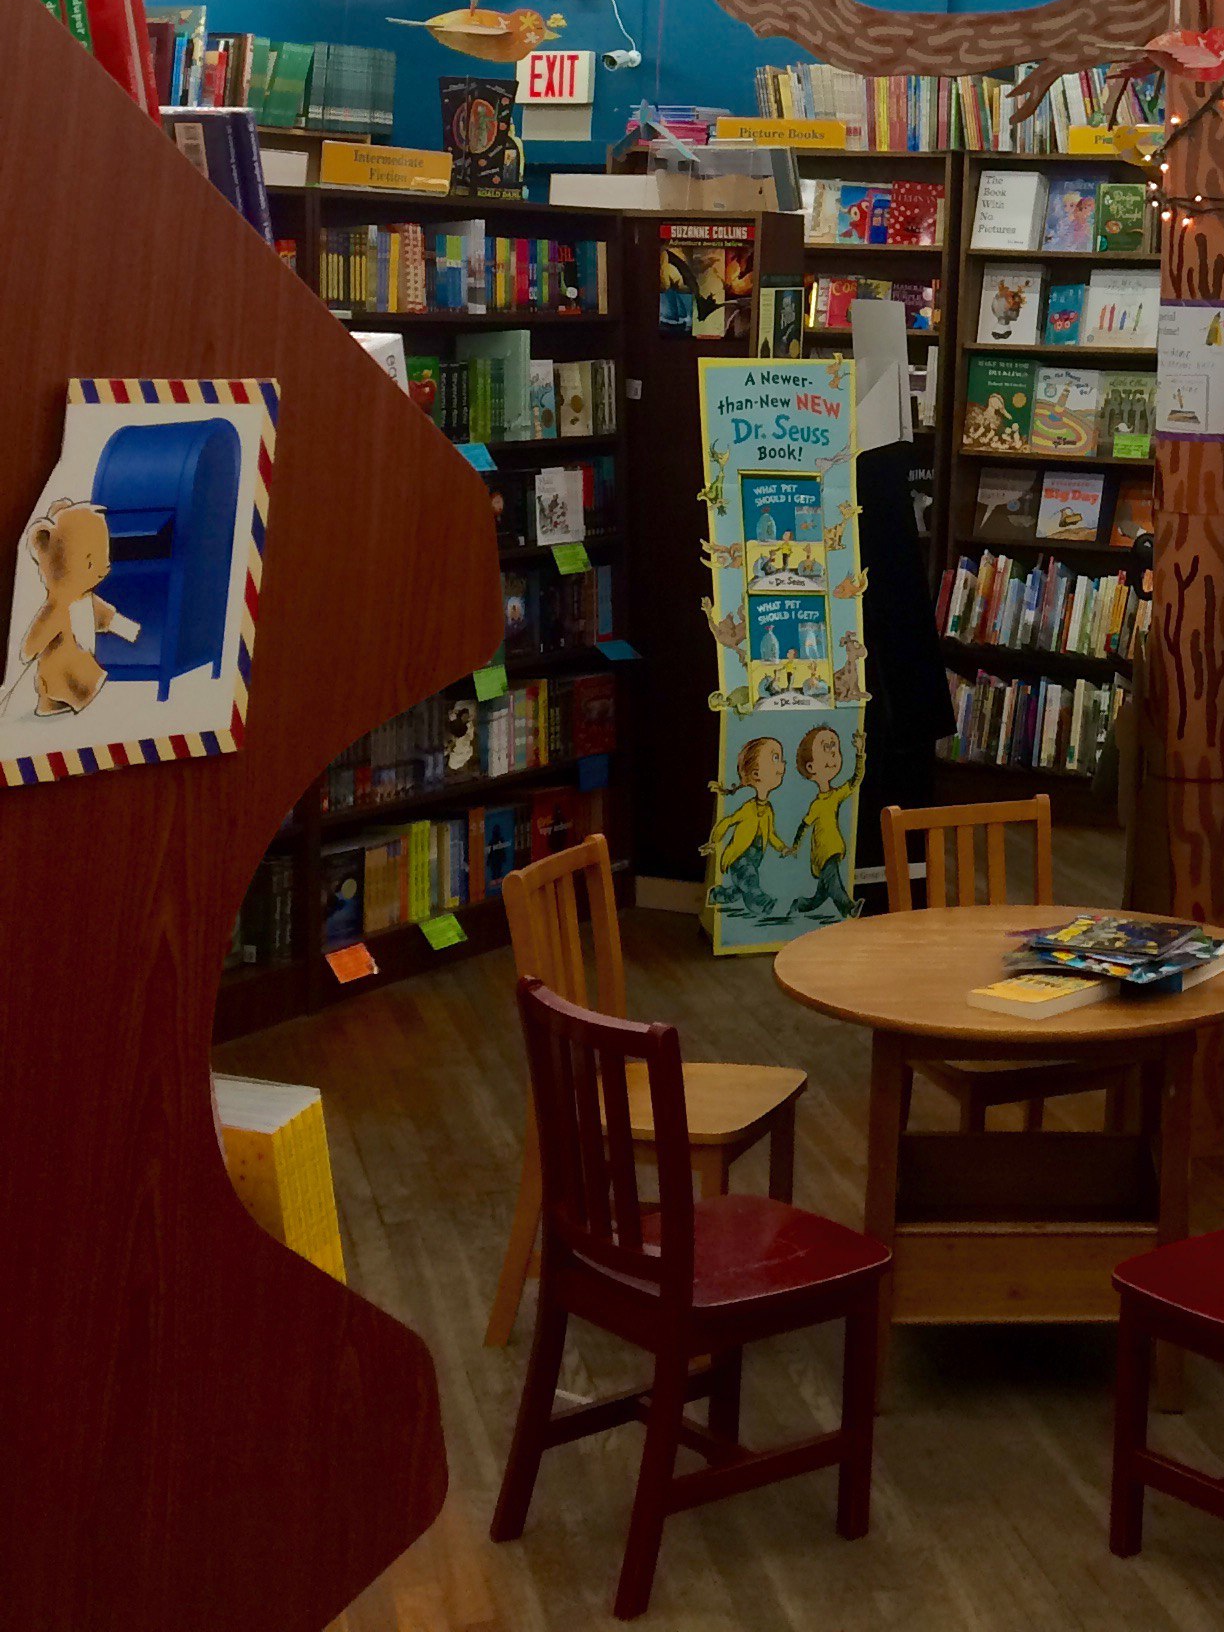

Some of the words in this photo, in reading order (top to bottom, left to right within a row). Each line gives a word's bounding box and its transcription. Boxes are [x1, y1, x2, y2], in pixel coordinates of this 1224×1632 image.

[529, 54, 579, 98] EXIT
[739, 127, 785, 140] Picture
[788, 128, 825, 140] Books
[353, 149, 425, 168] Intermediate
[368, 168, 408, 183] Fiction
[985, 175, 1004, 185] The
[983, 188, 1007, 198] Book
[981, 200, 1005, 210] With
[979, 212, 994, 222] No
[670, 225, 710, 238] SUZANNE
[712, 226, 748, 239] COLLINS
[977, 224, 1017, 235] Pictures
[744, 371, 756, 387] A
[760, 370, 813, 388] Newer-
[717, 394, 791, 416] than-New
[796, 393, 842, 419] NEW
[731, 417, 768, 445] Dr.
[772, 414, 831, 447] Seuss
[757, 444, 804, 462] Book!
[753, 484, 779, 495] WHAT
[781, 483, 798, 494] PET
[1044, 487, 1071, 503] Big
[1072, 489, 1100, 505] Day
[754, 494, 787, 508] SHOULD
[793, 493, 816, 505] GET?
[775, 577, 788, 587] Dr.
[788, 576, 806, 587] Seuss
[756, 600, 782, 613] WHAT
[784, 600, 801, 610] PET
[758, 610, 790, 626] SHOULD
[797, 610, 820, 621] GET?
[780, 698, 791, 707] Dr.
